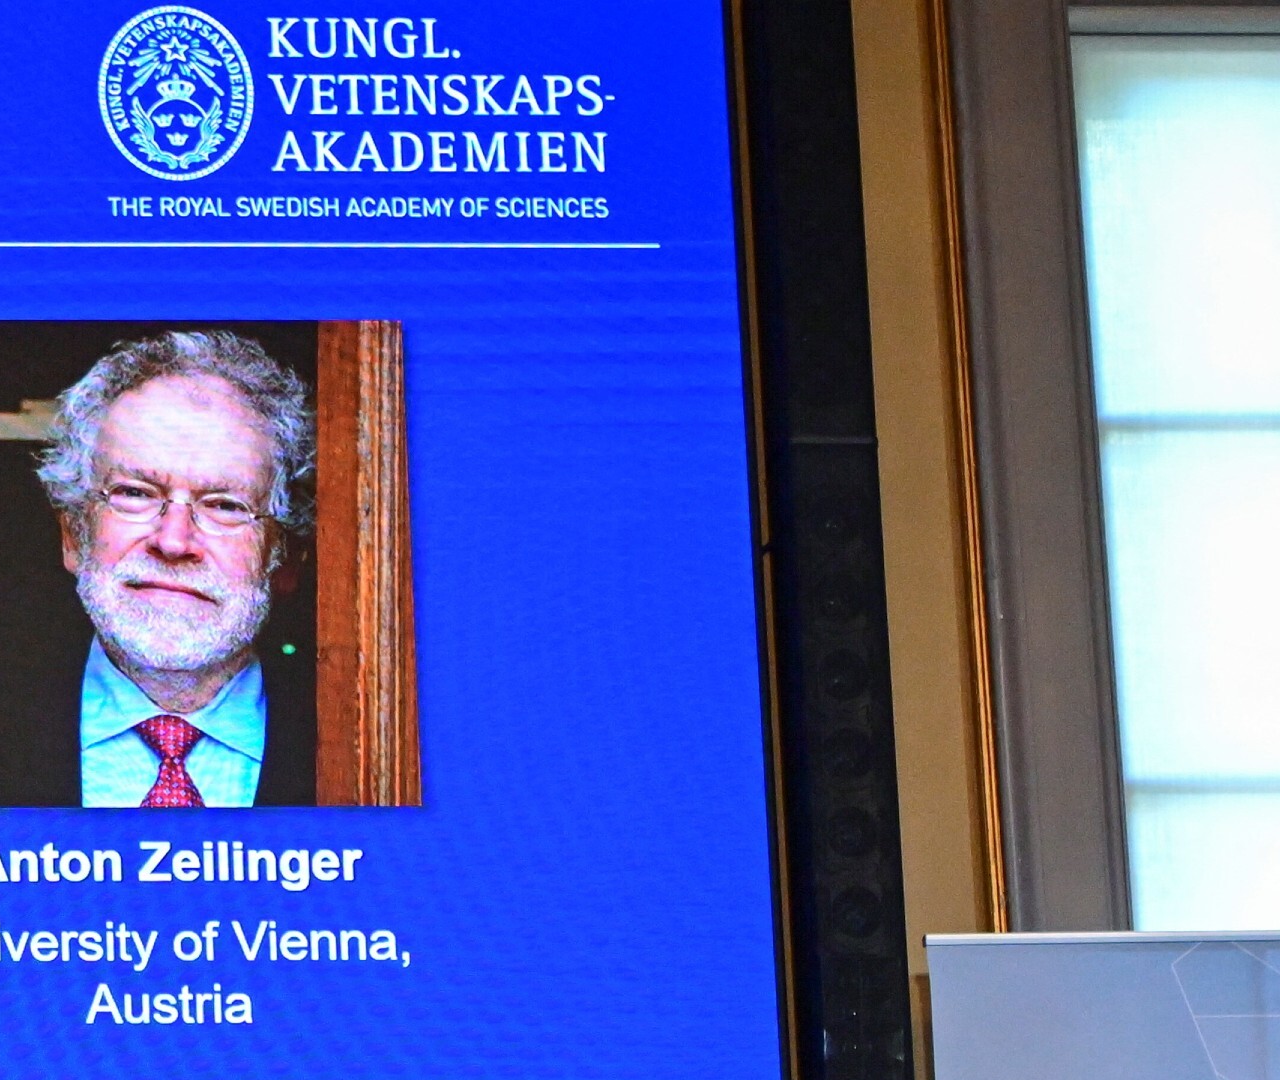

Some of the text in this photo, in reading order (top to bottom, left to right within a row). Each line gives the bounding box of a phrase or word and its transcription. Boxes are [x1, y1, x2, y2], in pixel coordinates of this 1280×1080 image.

[267, 17, 461, 59] KUNGL.
[268, 74, 615, 116] VETENSKAPS-
[272, 131, 607, 173] AKADEMIEN
[108, 196, 609, 218] THE ROYAL SWEDISH ACADEMY OF SCIENCES
[138, 841, 363, 891] Zeilinger
[173, 920, 220, 961] of
[231, 920, 410, 968] Vienna,
[86, 983, 253, 1024] Austria
